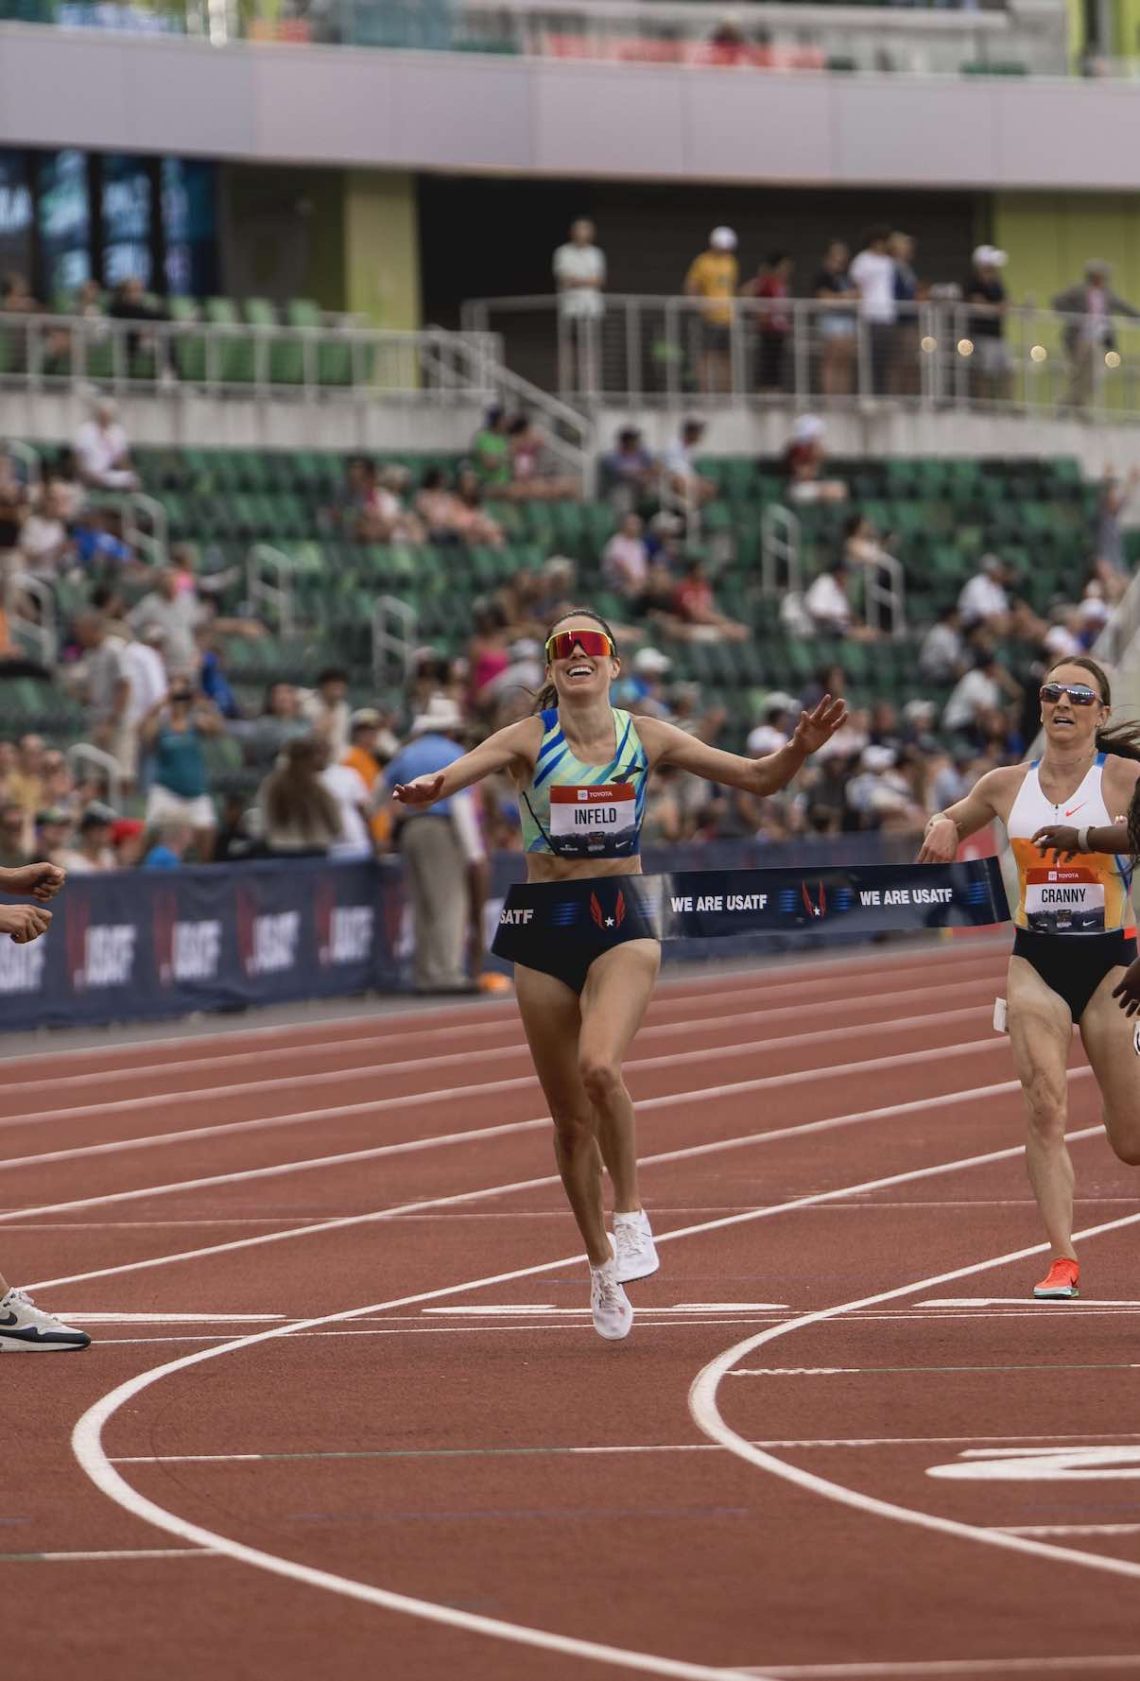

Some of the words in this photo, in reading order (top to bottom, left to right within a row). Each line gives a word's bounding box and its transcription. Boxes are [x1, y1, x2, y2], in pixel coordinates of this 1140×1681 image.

[589, 790, 614, 798] TOYOTA
[574, 807, 617, 825] INFELD
[670, 896, 693, 912] WE
[696, 895, 723, 912] ARE
[726, 894, 768, 911] USATF
[860, 890, 881, 906] WE
[883, 889, 910, 905] ARE
[912, 888, 953, 904] USATF
[1041, 888, 1086, 903] CRANNY
